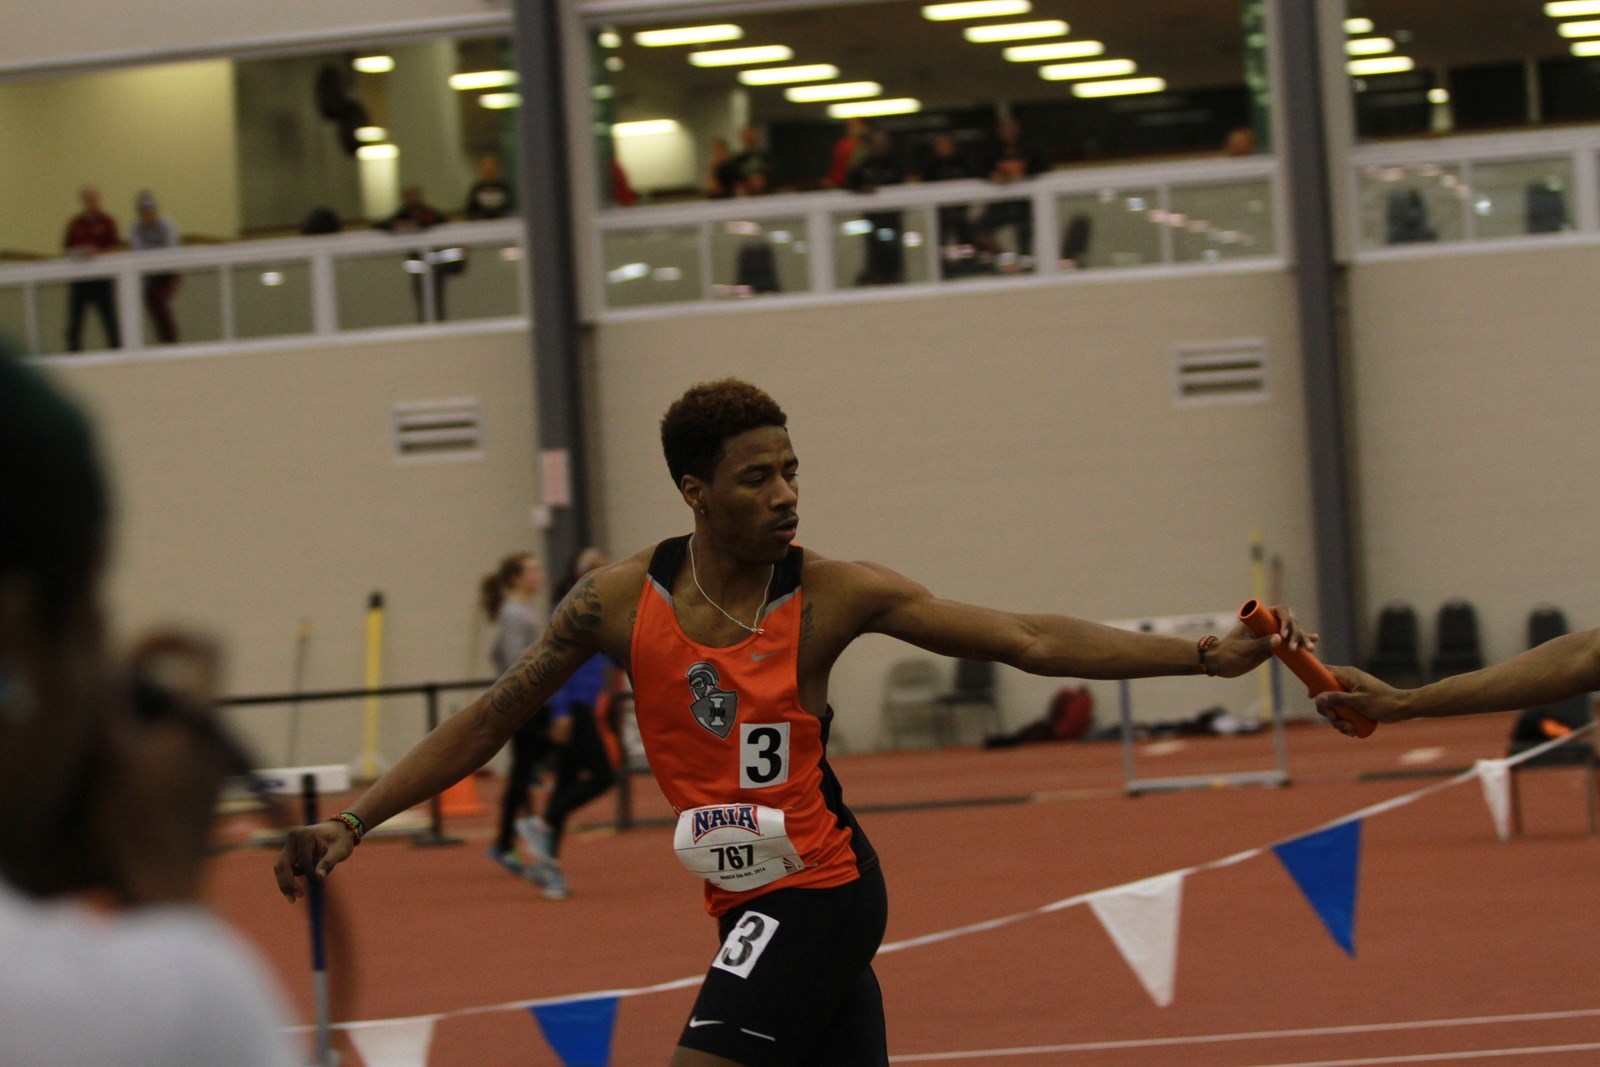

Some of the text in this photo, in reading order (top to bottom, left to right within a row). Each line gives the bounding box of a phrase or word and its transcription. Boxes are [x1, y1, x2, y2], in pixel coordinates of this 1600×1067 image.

[746, 727, 782, 784] 3
[694, 807, 758, 838] NAIA
[710, 844, 754, 871] 767
[721, 915, 765, 967] 3
